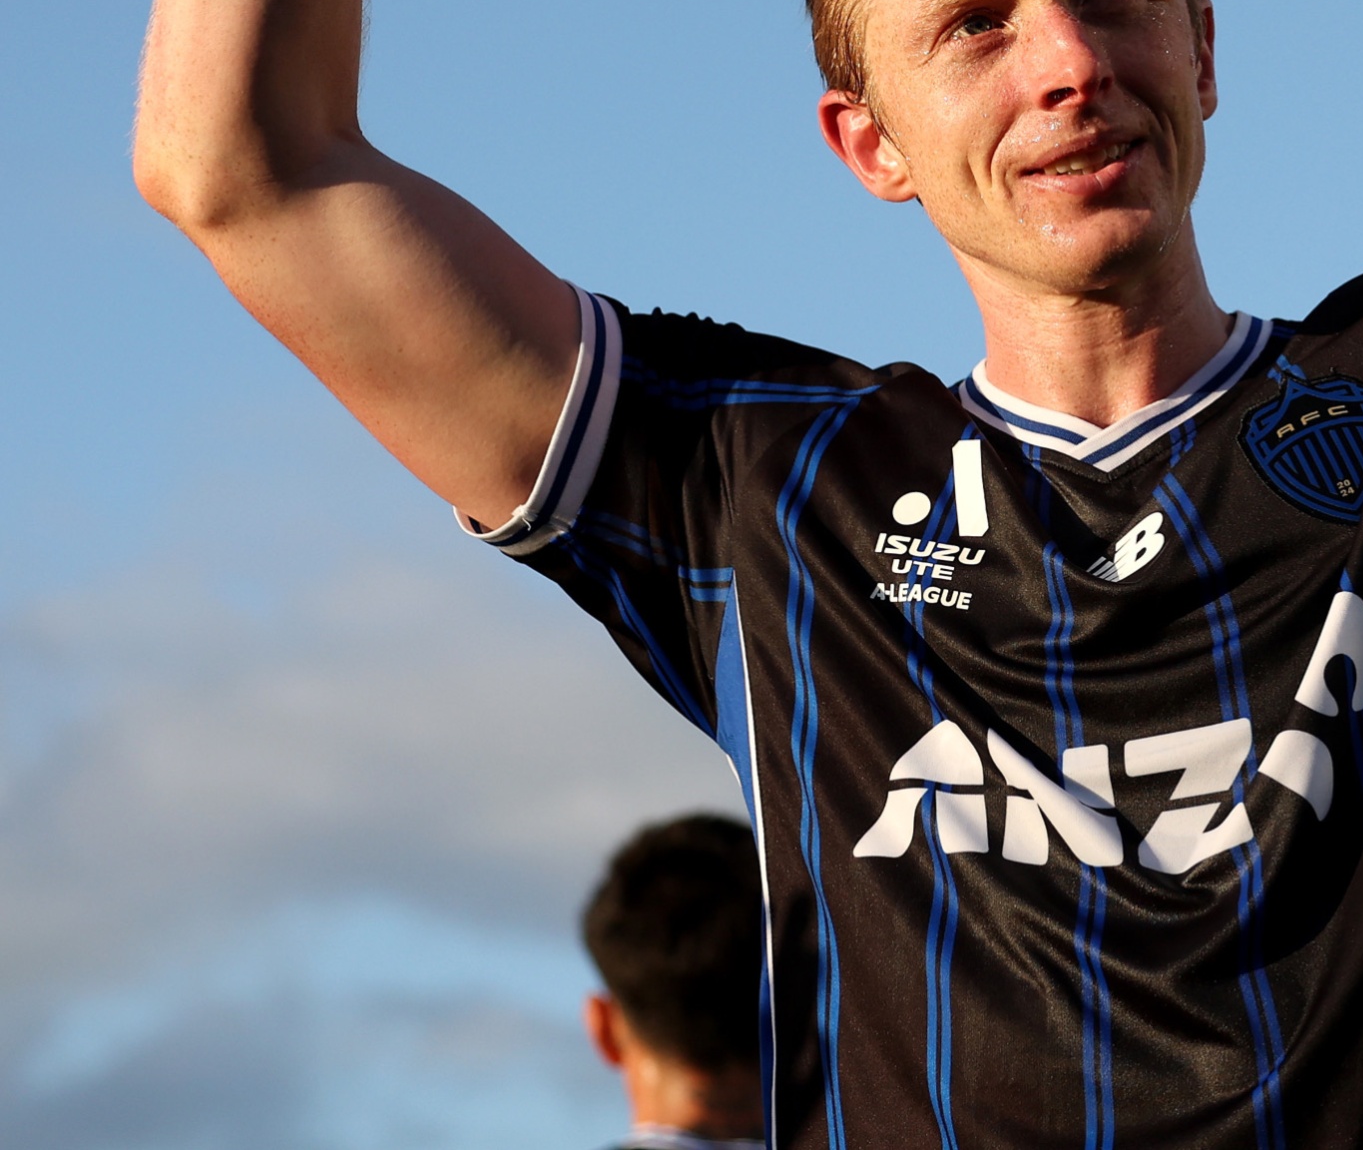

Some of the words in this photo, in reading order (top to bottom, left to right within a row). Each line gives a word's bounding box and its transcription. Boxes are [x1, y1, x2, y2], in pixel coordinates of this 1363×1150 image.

[1336, 479, 1351, 489] 20
[1340, 486, 1355, 497] 24
[874, 532, 986, 565] ISUZU
[891, 558, 955, 581] UTE
[869, 582, 973, 610] A-LEAGUE
